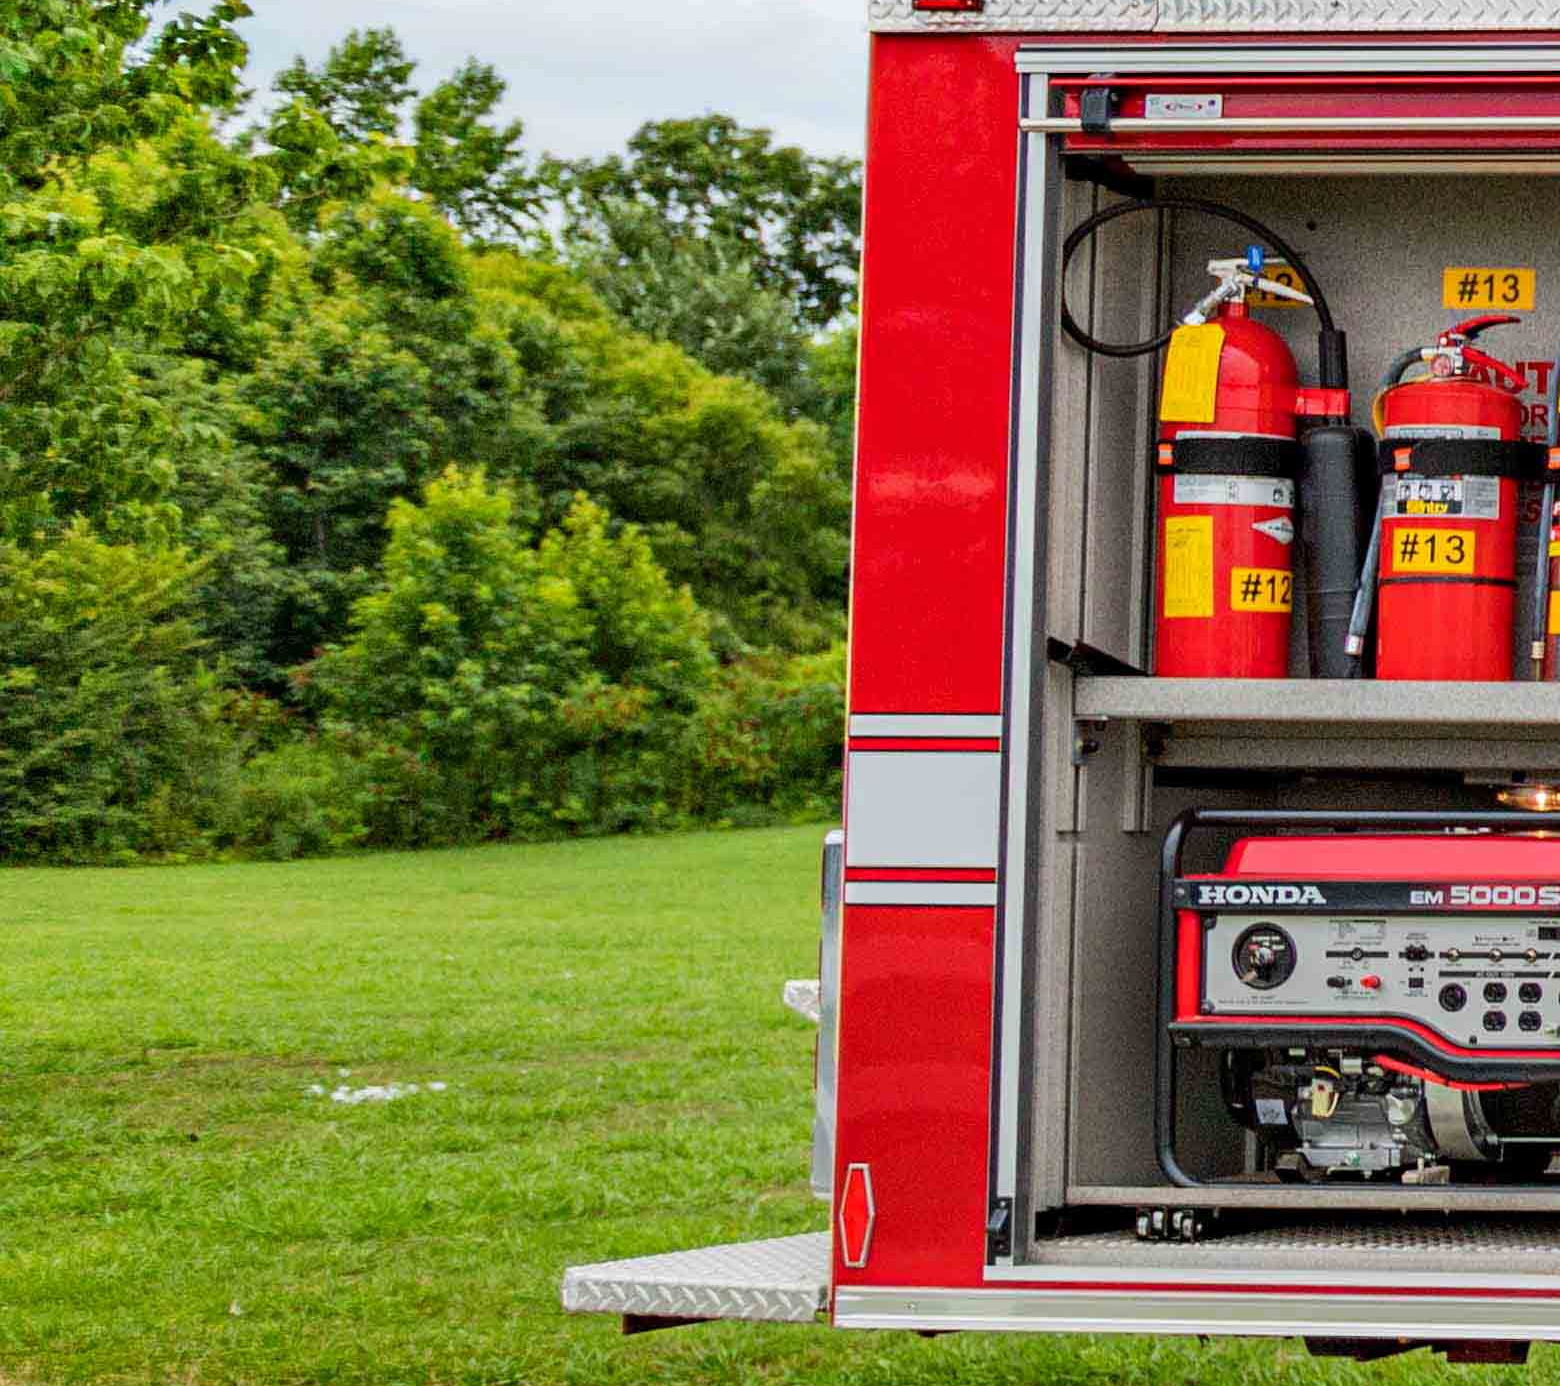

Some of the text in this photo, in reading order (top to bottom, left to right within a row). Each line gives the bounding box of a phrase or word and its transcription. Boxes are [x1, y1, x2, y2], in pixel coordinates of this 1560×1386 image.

[1457, 273, 1520, 303] #13
[1400, 532, 1466, 564] #13
[1241, 573, 1291, 604] #12
[1198, 885, 1328, 905] HONDA
[1410, 890, 1444, 905] EM
